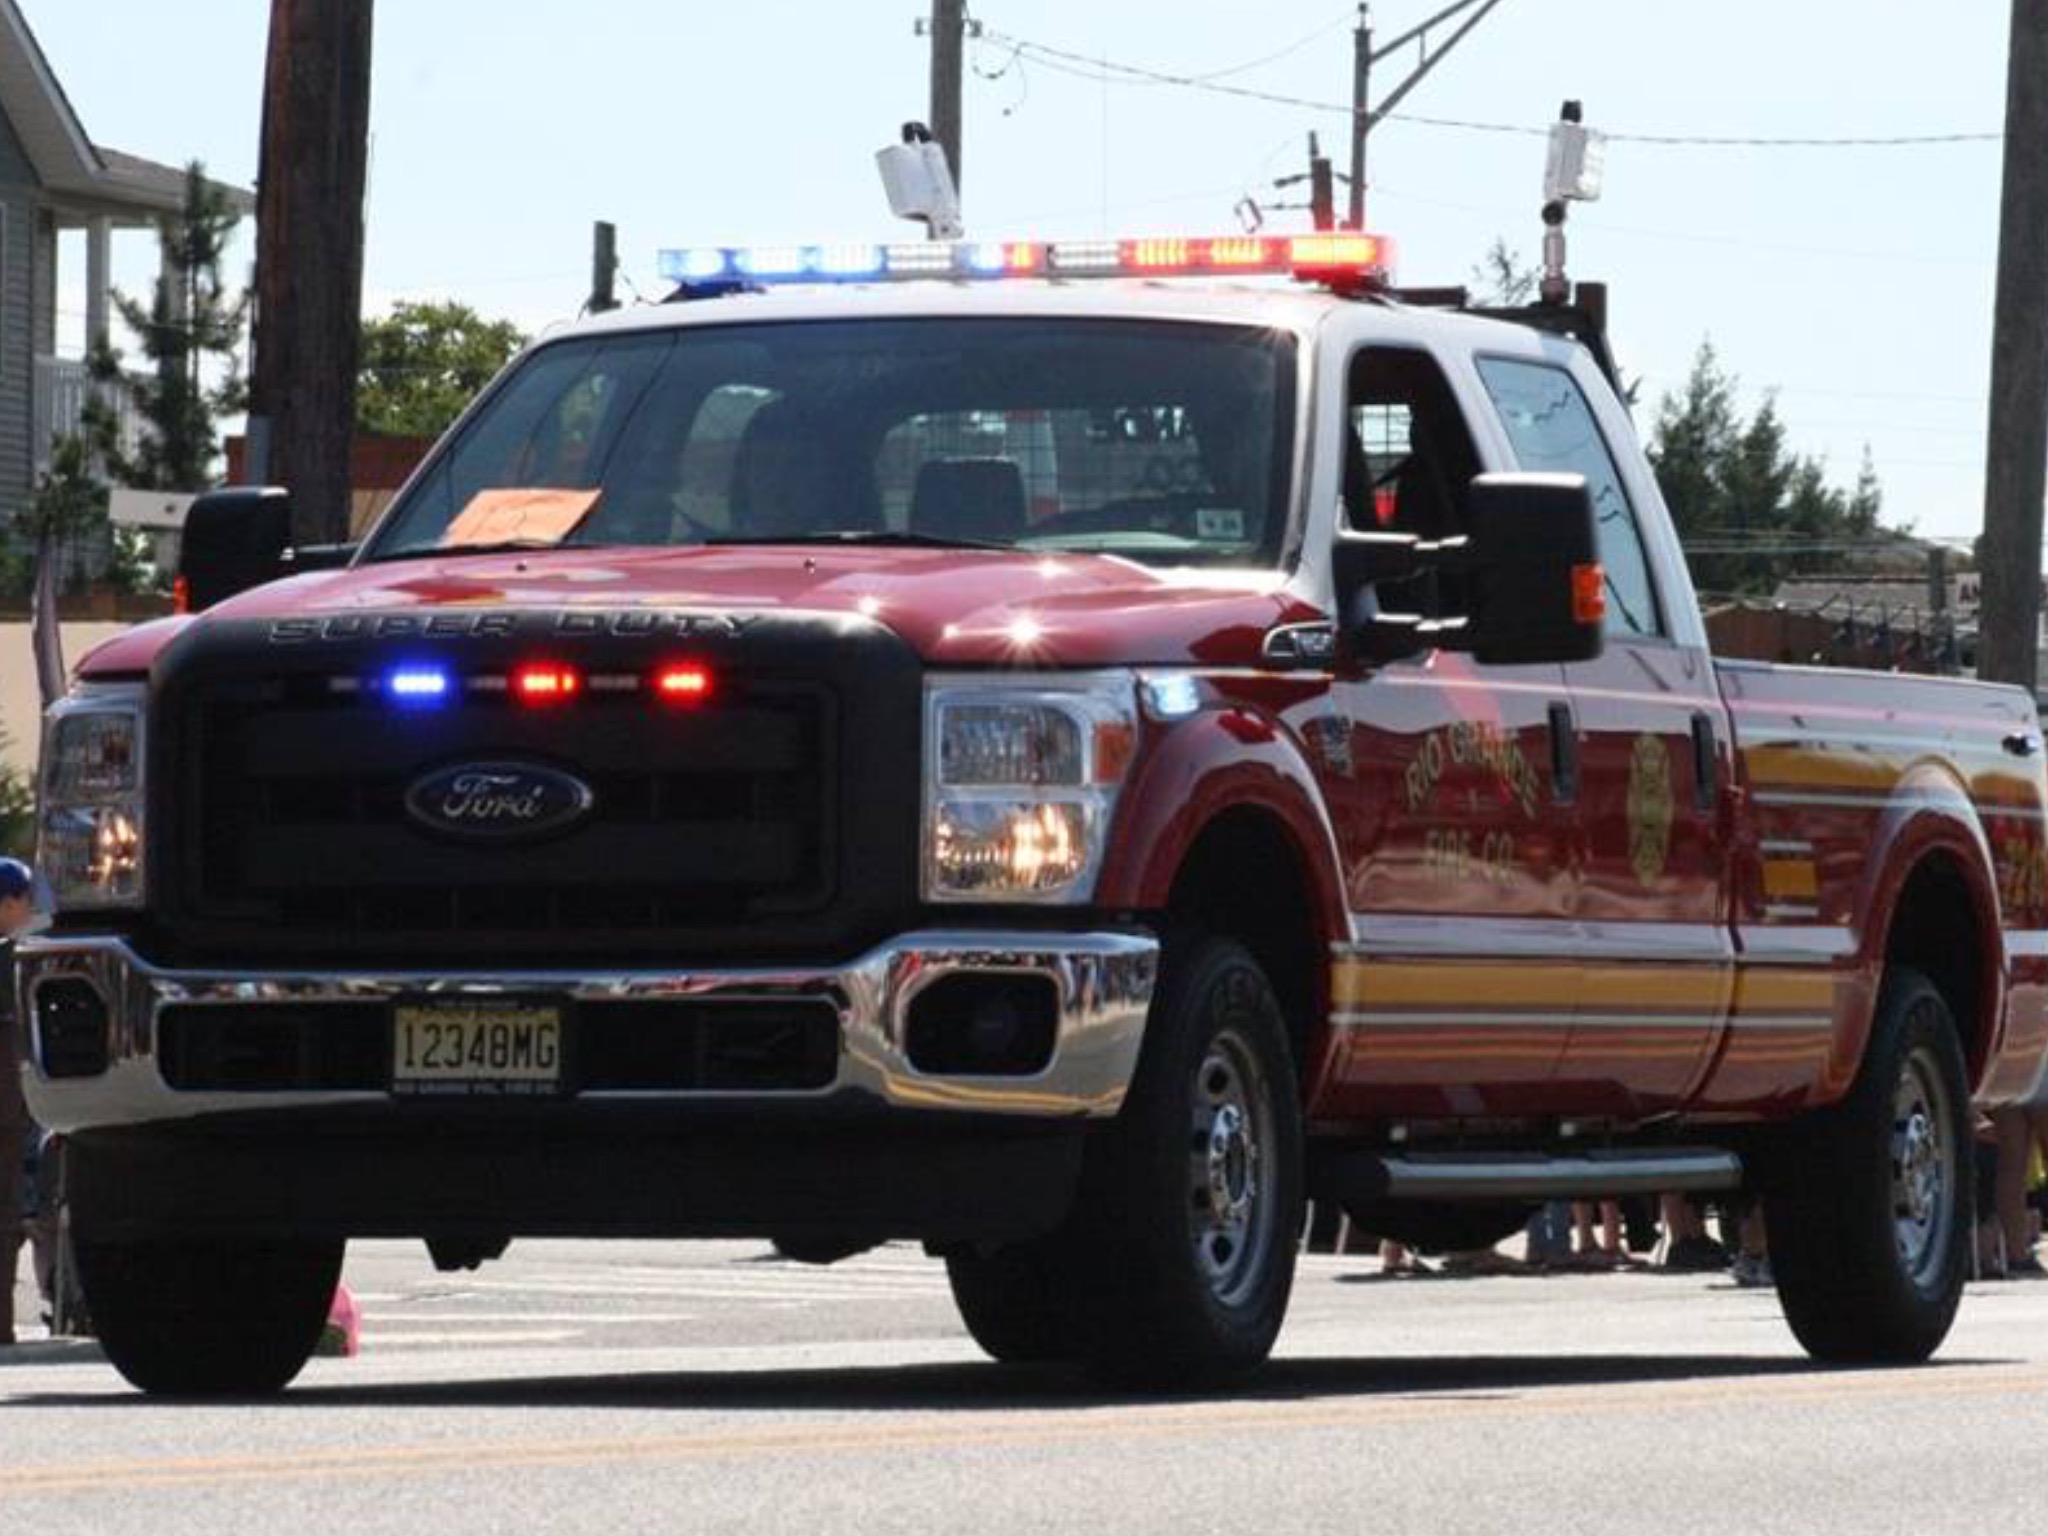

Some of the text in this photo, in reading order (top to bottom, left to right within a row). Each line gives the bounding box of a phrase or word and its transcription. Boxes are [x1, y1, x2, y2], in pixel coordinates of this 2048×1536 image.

[268, 612, 762, 643] SUPER DUTY
[1406, 732, 1442, 813] RIO
[443, 774, 543, 818] Ford
[405, 1023, 554, 1068] 12348MG
